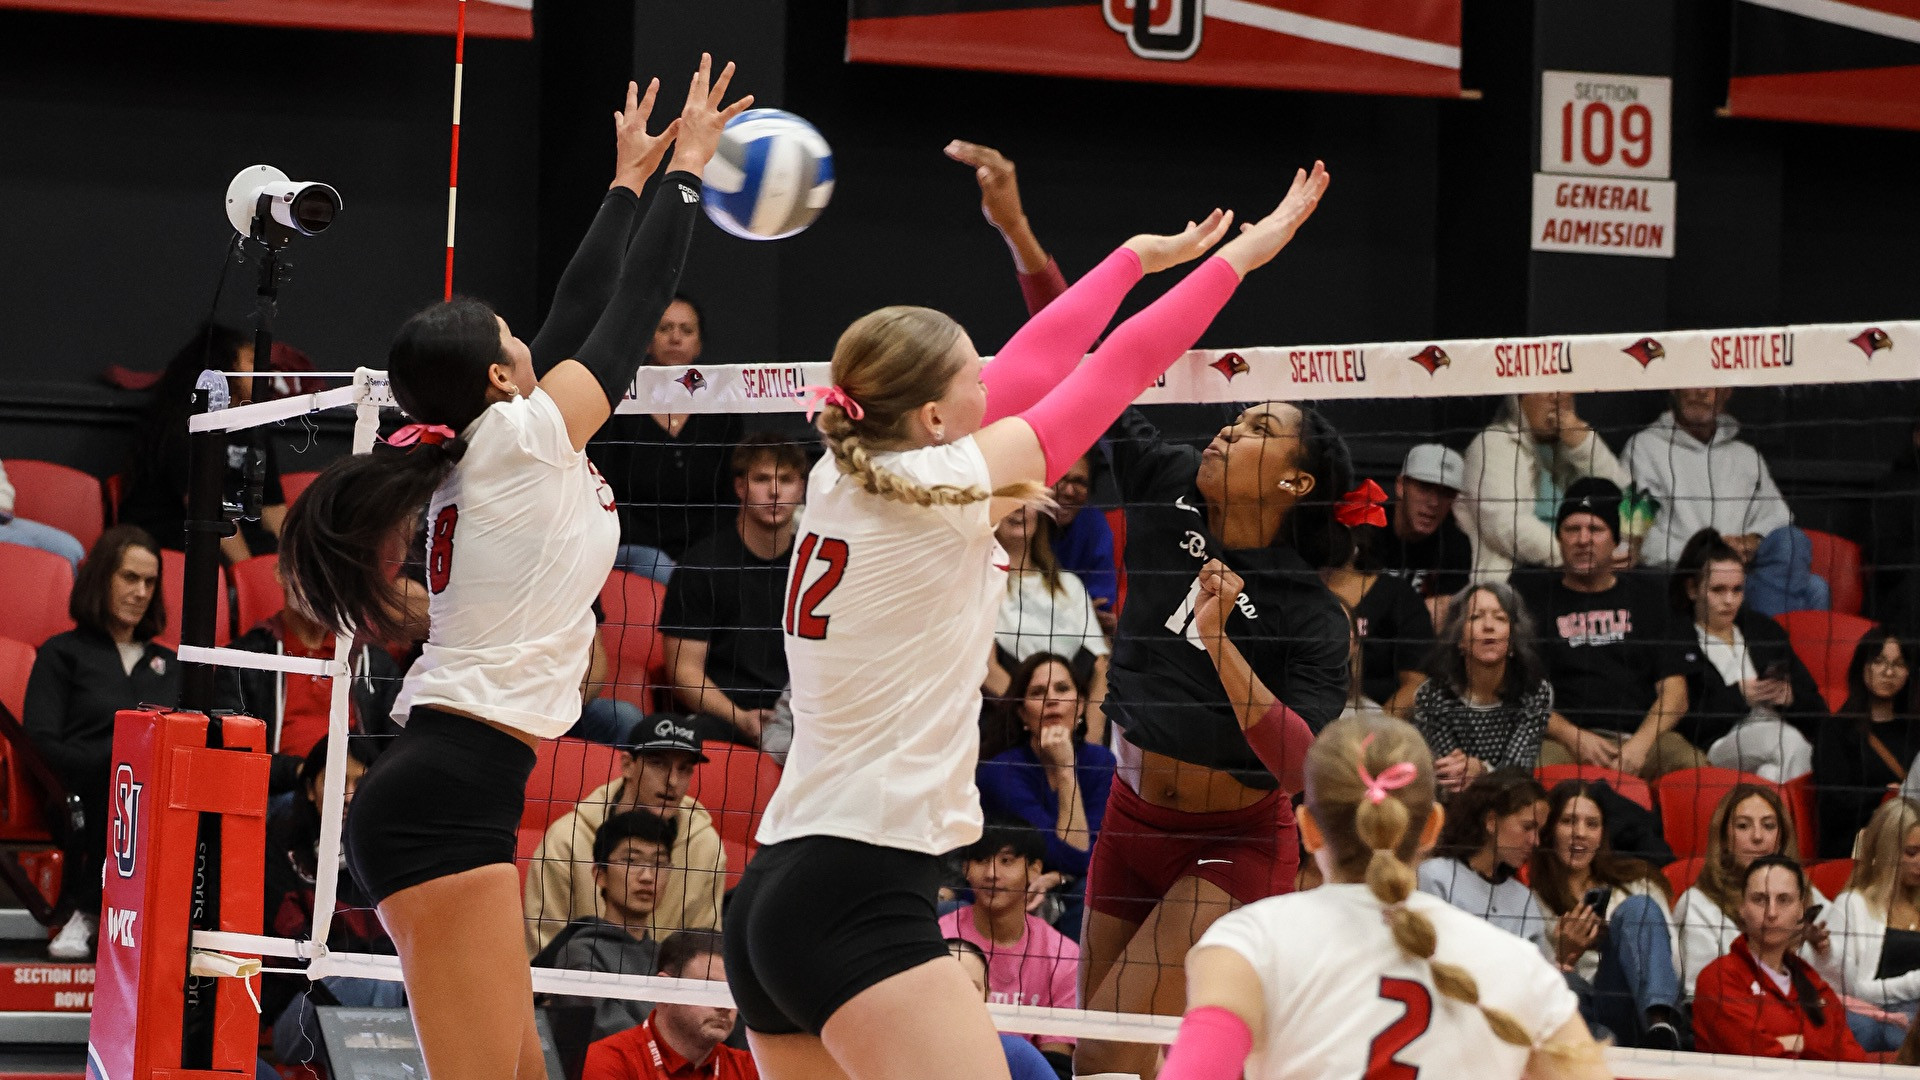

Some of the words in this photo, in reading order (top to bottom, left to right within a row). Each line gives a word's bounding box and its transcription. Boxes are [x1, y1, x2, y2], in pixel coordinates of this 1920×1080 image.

[1574, 82, 1639, 101] SECTION
[1562, 101, 1653, 168] 109
[1555, 182, 1652, 212] GENERAL
[1541, 218, 1664, 248] ADMISSION
[430, 503, 458, 595] 8
[785, 531, 849, 640] 12
[107, 907, 138, 948] WCC
[14, 968, 72, 984] SECTION
[55, 991, 86, 1008] ROW
[1360, 975, 1433, 1080] 2
